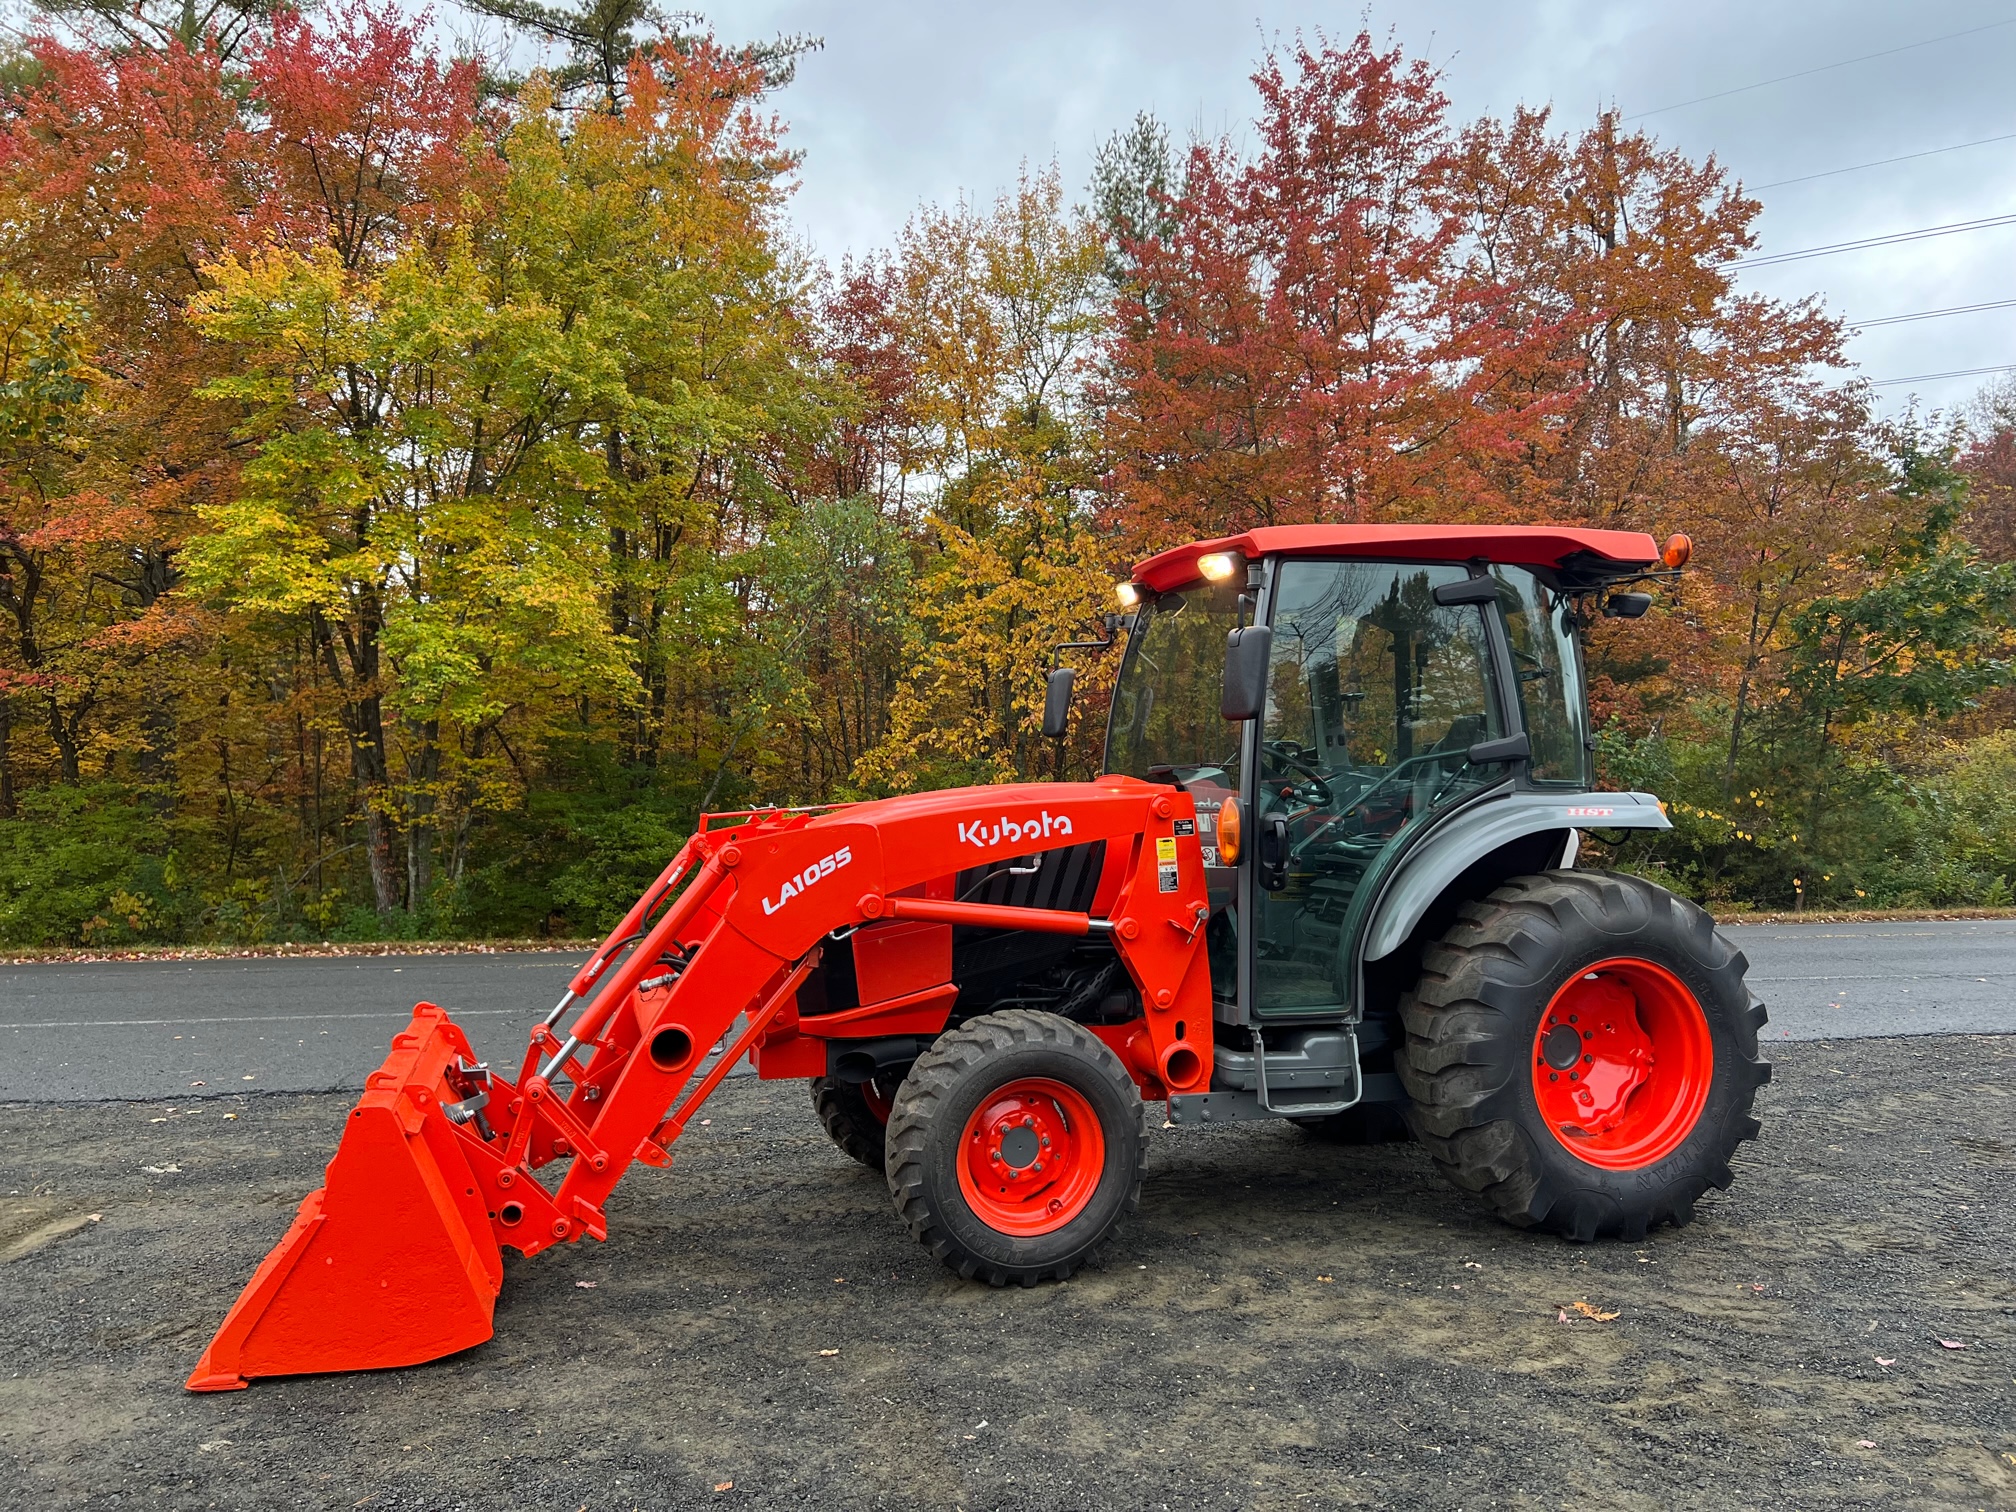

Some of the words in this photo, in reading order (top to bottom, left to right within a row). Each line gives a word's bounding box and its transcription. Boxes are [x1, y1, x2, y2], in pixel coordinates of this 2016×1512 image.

[957, 810, 1073, 849] Kubota
[1568, 808, 1613, 816] HST
[761, 845, 852, 916] LA1055
[1635, 1134, 1708, 1193] TITAN
[956, 1225, 1025, 1265] TITAN
